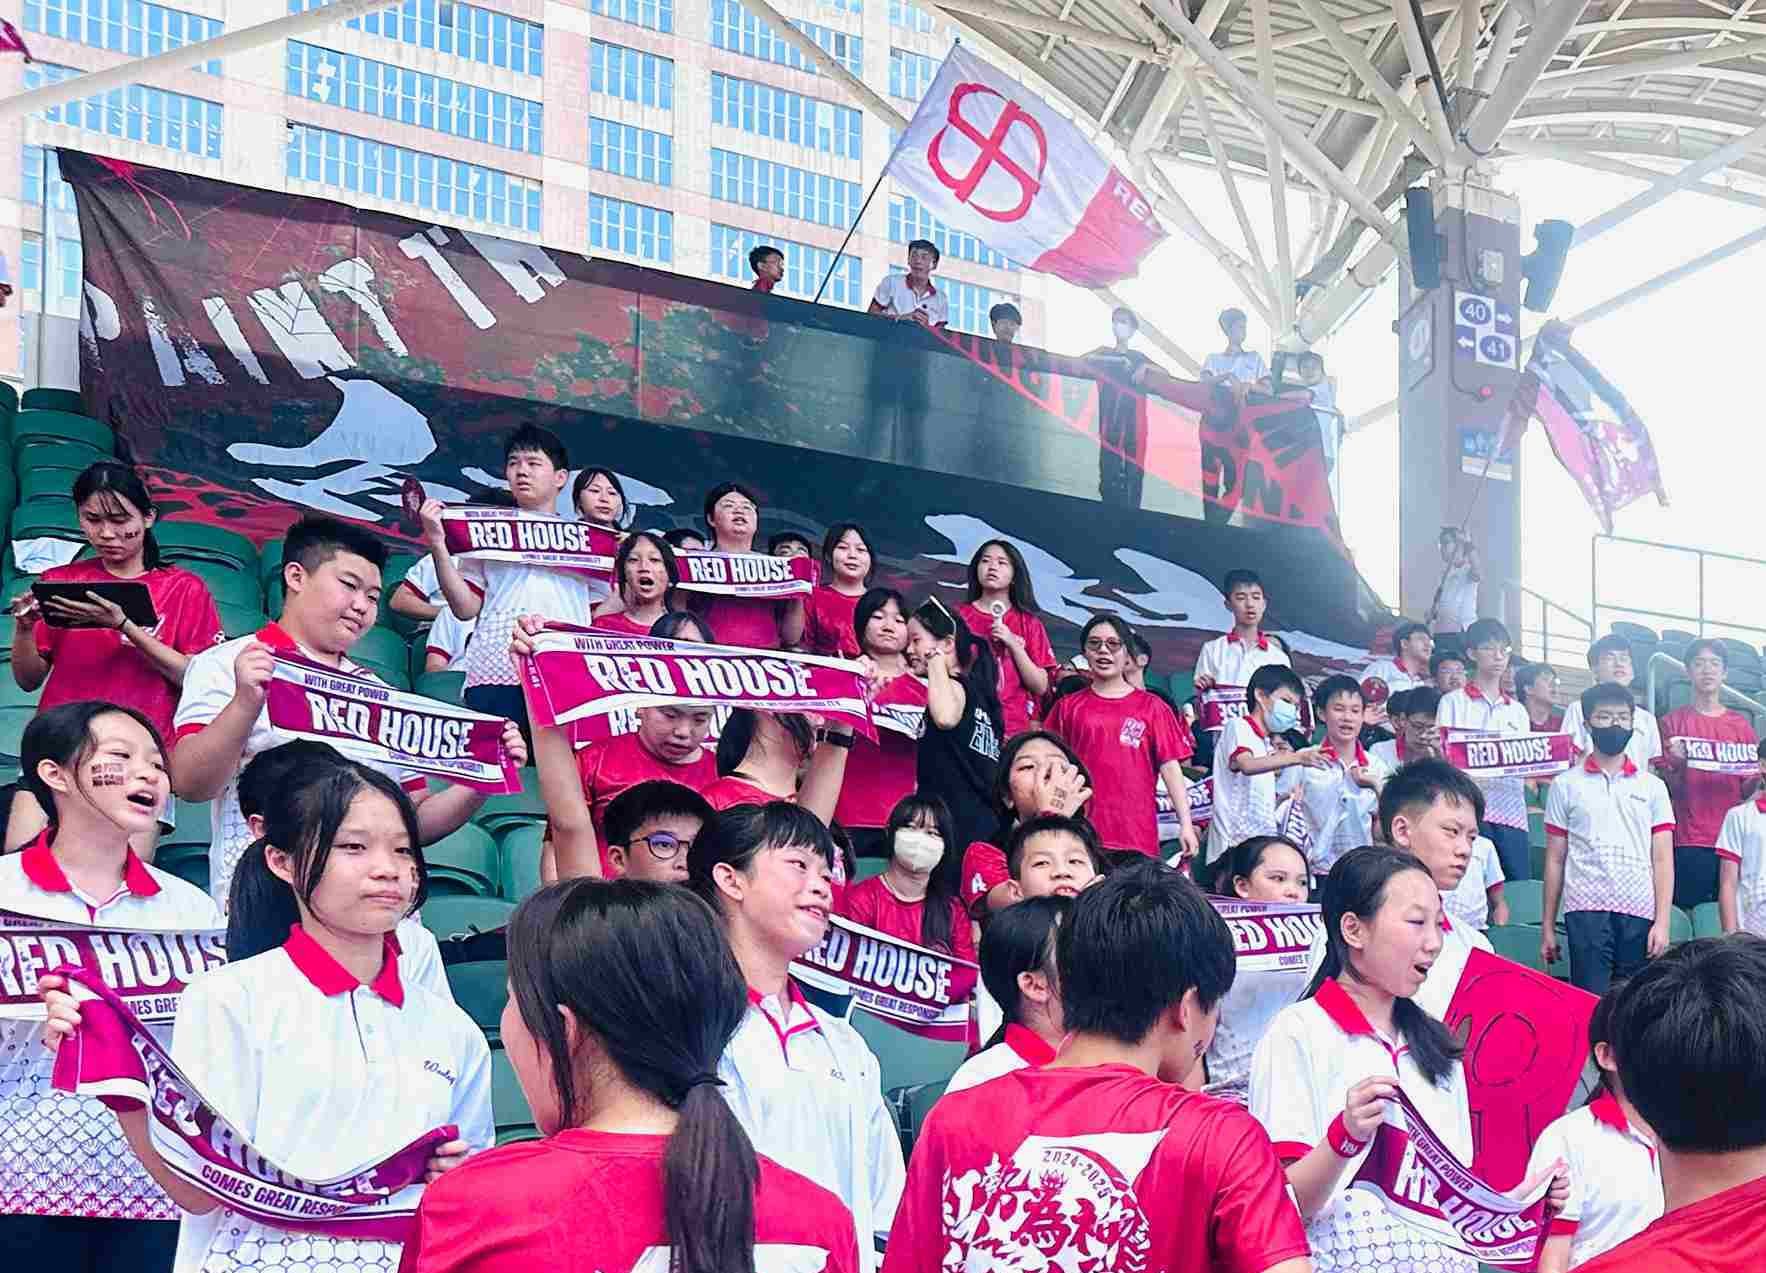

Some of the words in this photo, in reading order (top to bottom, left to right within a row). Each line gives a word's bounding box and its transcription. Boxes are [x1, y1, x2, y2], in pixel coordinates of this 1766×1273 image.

[1465, 303, 1486, 322] 40
[1487, 340, 1506, 359] 41
[467, 520, 513, 549] RED
[518, 520, 592, 552] HOUSE
[688, 557, 726, 582] RED
[730, 558, 794, 583] HOUSE
[304, 673, 329, 689] WITH
[330, 678, 357, 694] GREAT
[358, 684, 390, 701] POWER
[584, 654, 677, 695] RED
[678, 656, 817, 698] HOUSE
[304, 691, 371, 742] RED
[378, 708, 476, 759] HOUSE
[1467, 741, 1499, 768] RED
[1501, 737, 1552, 766] HOUSE
[852, 935, 953, 1005] HOUSE
[1041, 1149, 1111, 1198] 2024-2025
[1415, 1136, 1442, 1166] GREAT
[1440, 1160, 1475, 1193] POWER
[201, 1163, 255, 1200] COMES
[254, 1186, 300, 1211] GREAT
